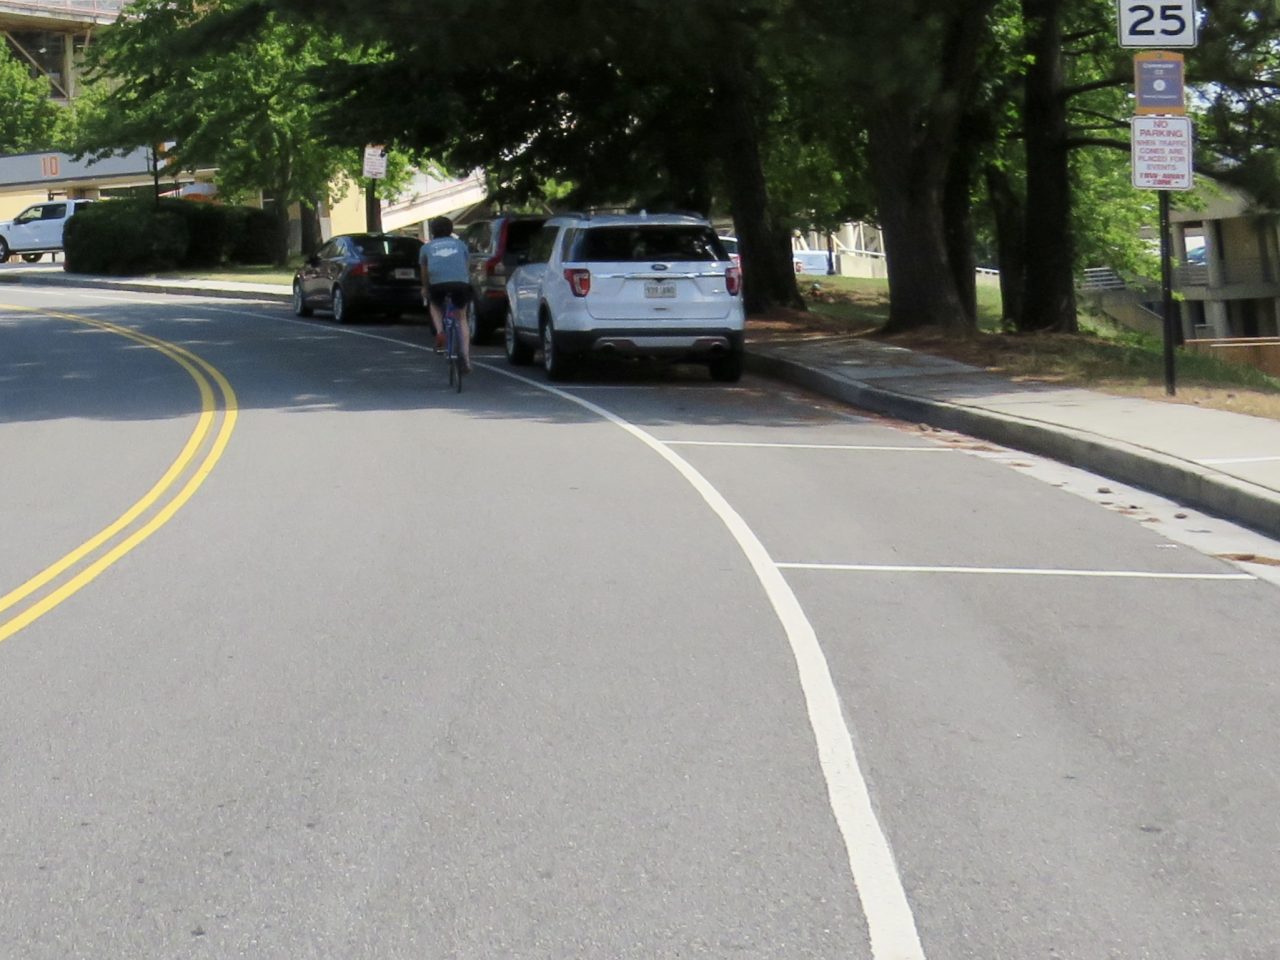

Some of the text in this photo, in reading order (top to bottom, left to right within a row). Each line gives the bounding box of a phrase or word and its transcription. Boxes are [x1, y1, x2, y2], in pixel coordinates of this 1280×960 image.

[1128, 5, 1186, 35] 25
[1153, 120, 1168, 128] NO
[1139, 129, 1183, 137] PARKING
[42, 156, 59, 176] 10
